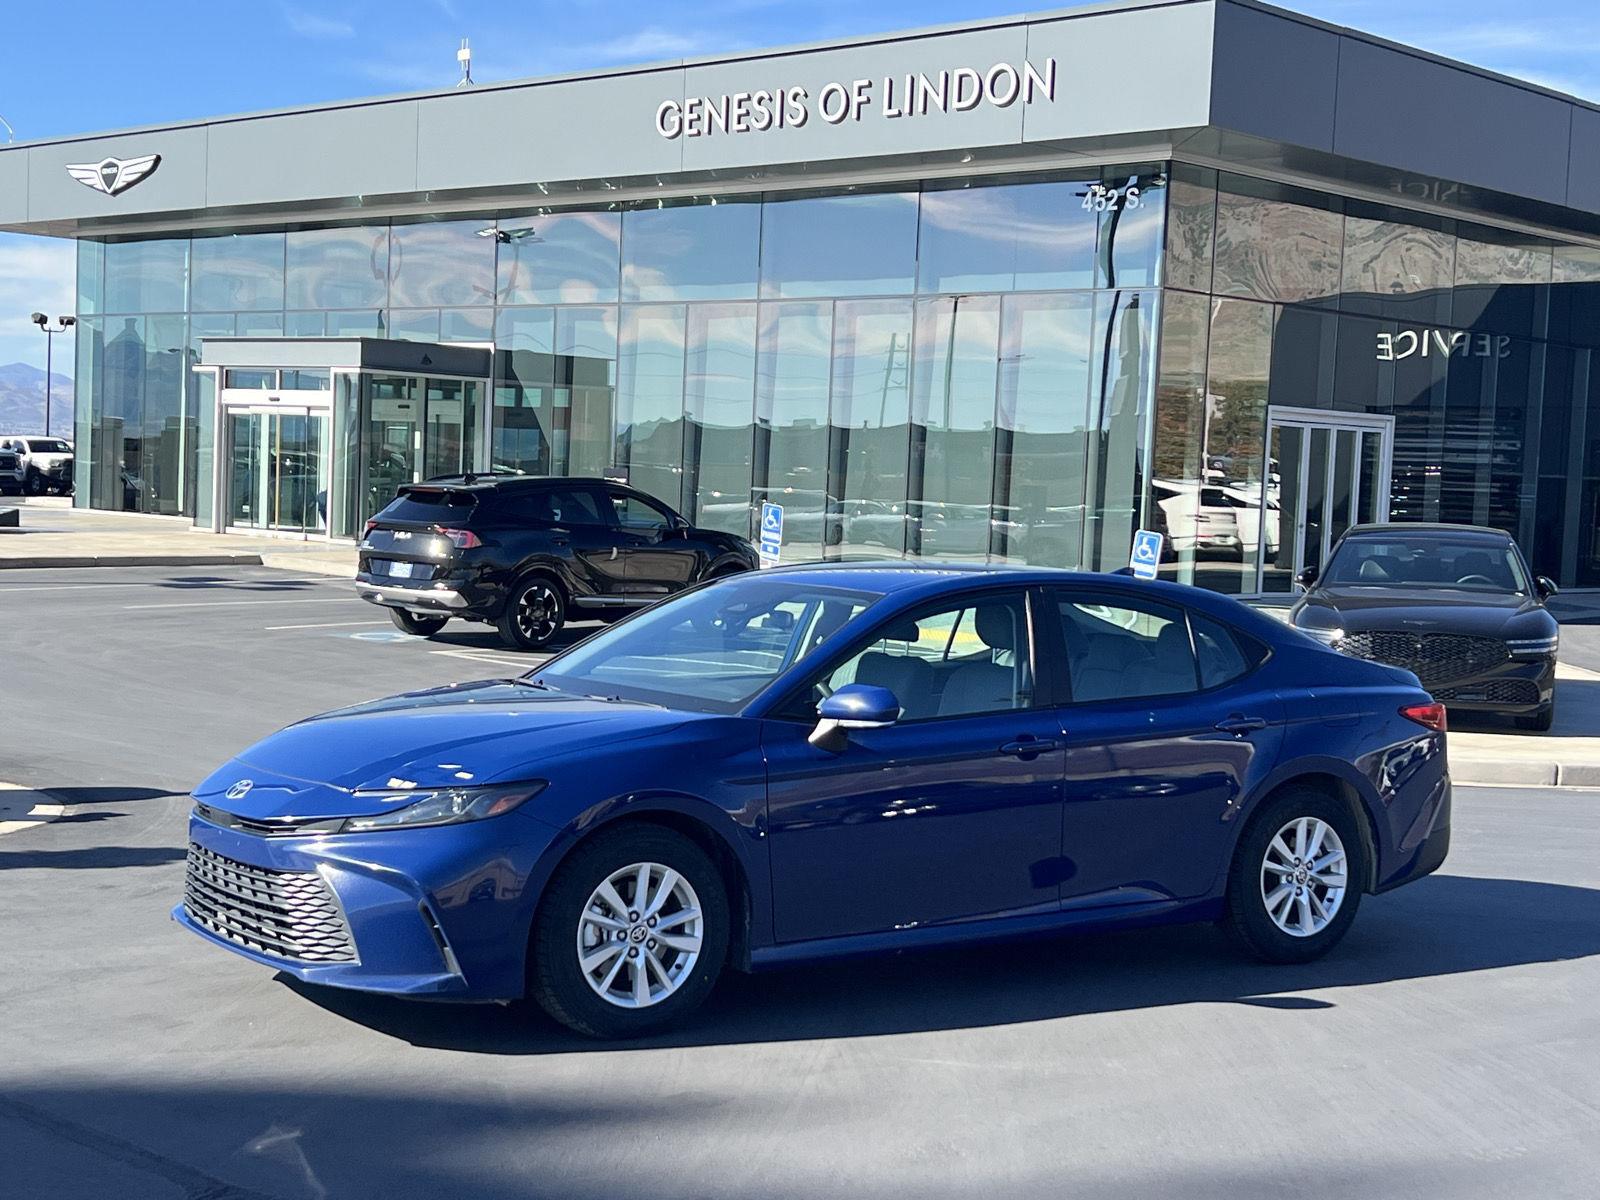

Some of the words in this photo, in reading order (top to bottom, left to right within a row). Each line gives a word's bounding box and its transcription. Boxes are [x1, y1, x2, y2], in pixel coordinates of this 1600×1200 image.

[655, 86, 808, 140] GENESIS
[818, 79, 872, 124] OF
[882, 58, 1056, 118] LINDON
[1081, 188, 1118, 212] 452
